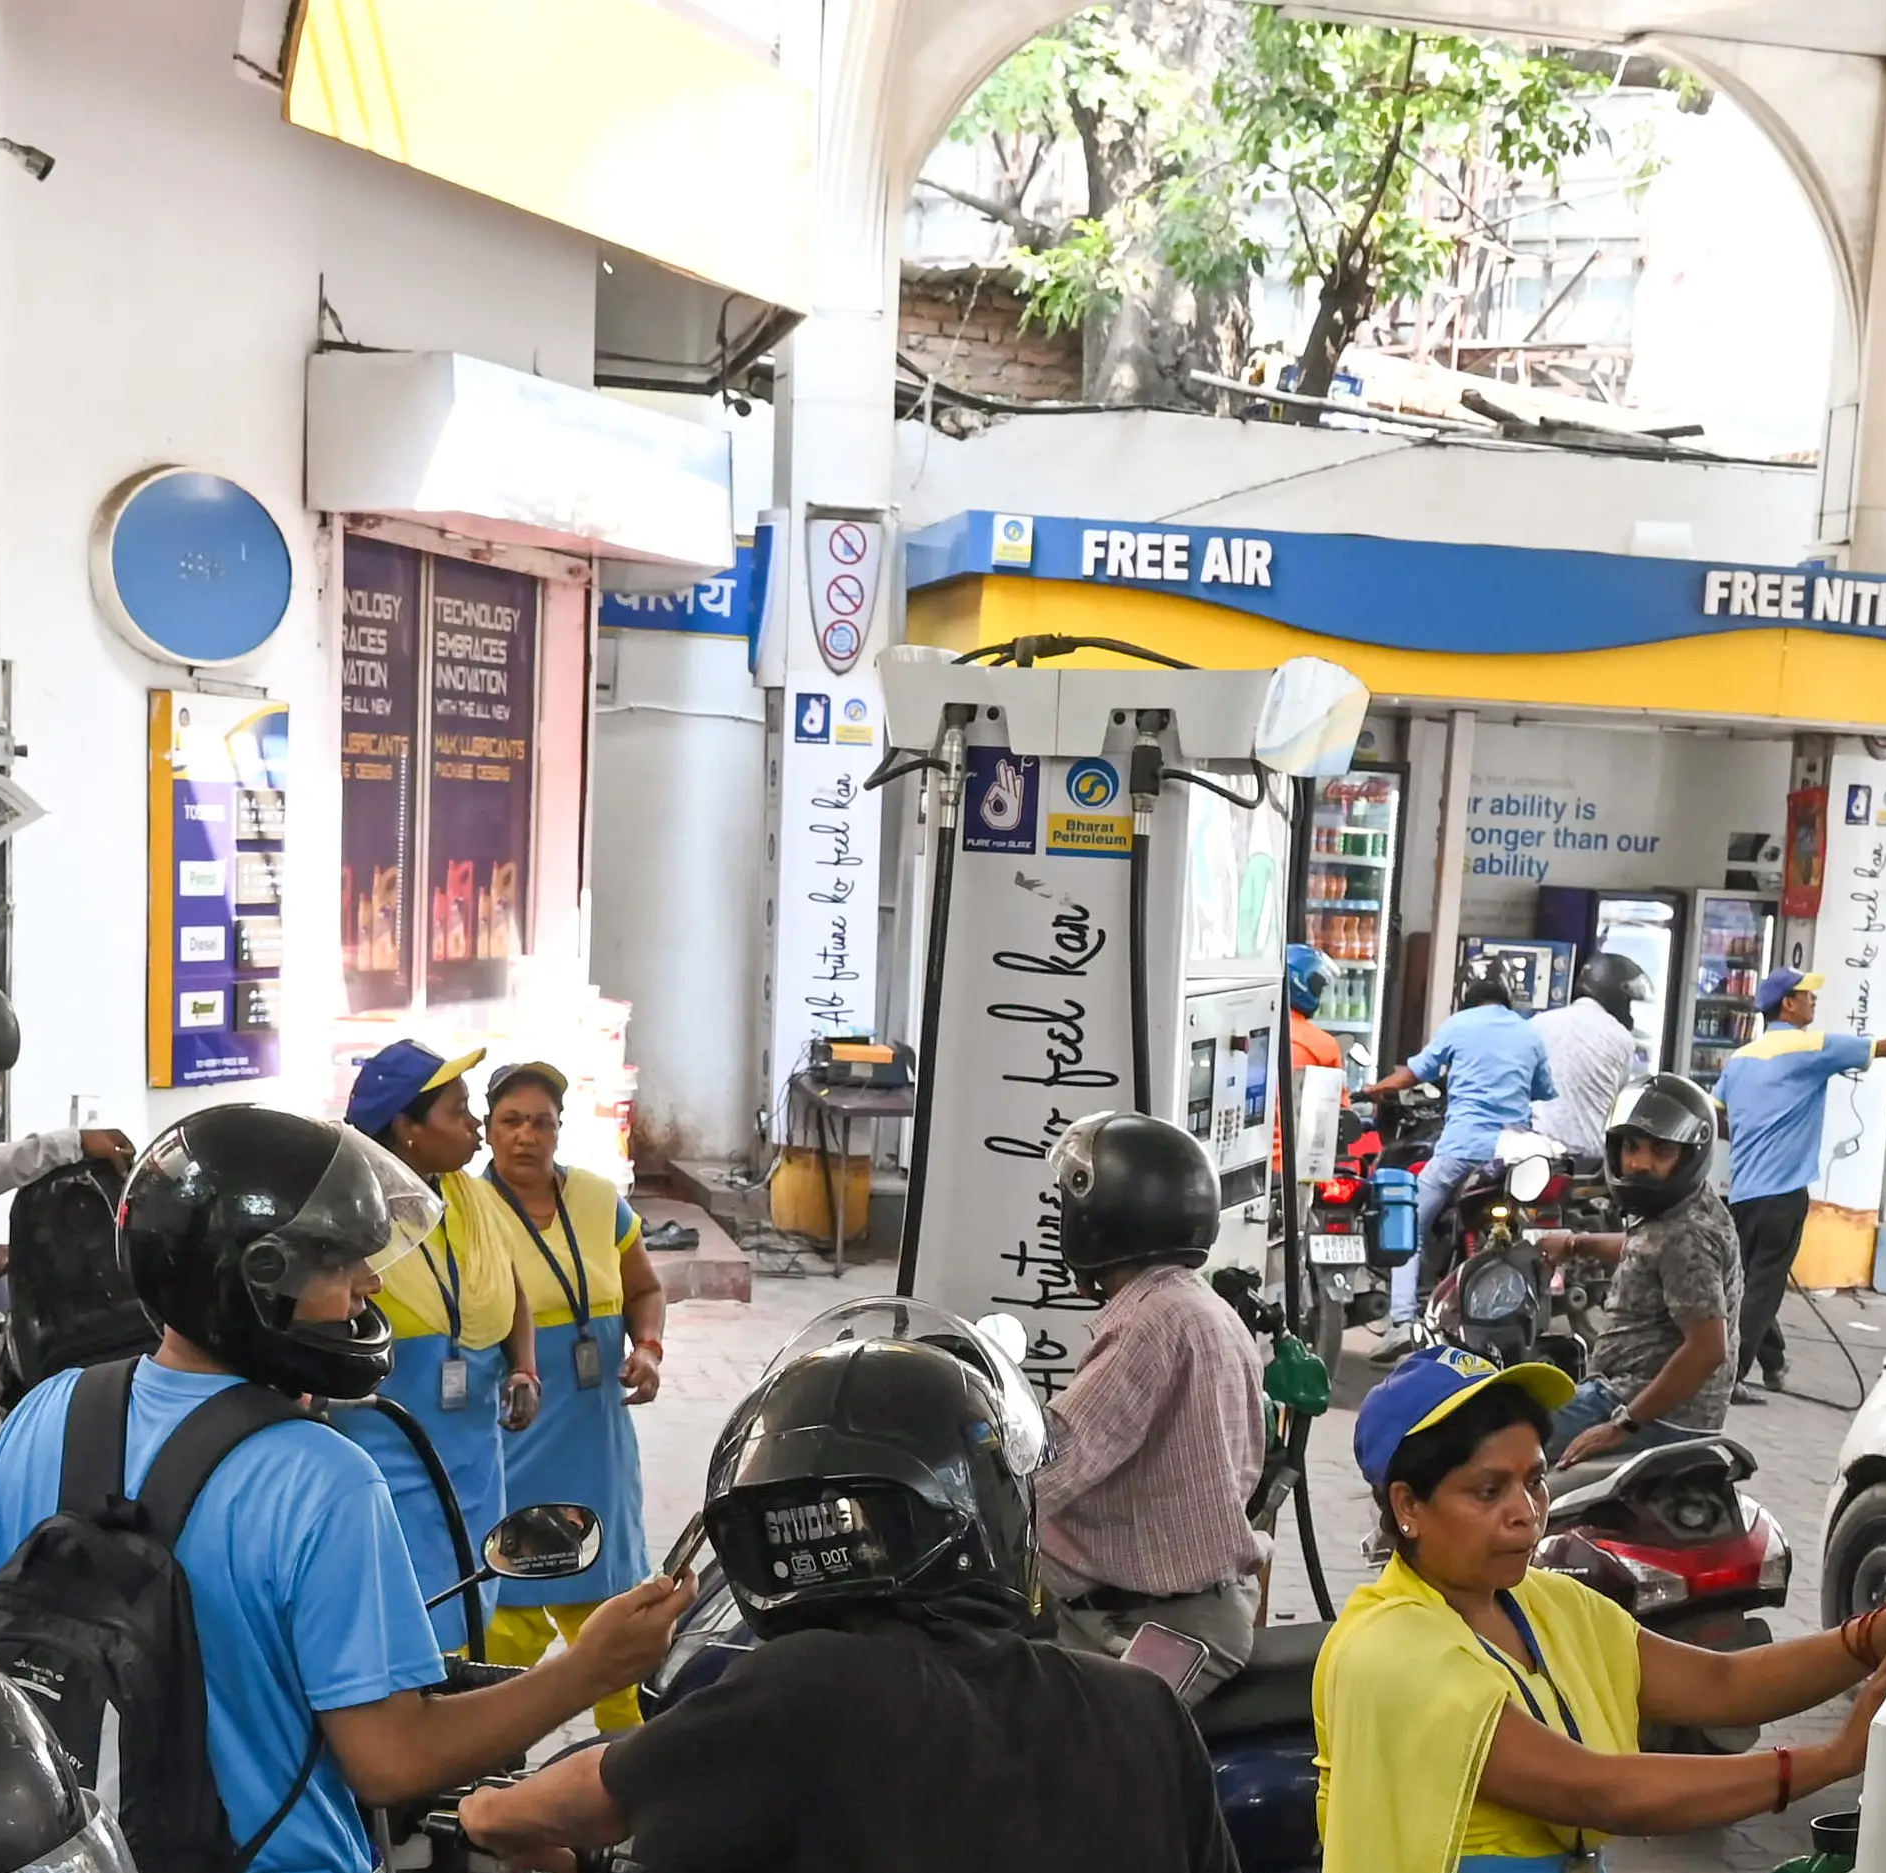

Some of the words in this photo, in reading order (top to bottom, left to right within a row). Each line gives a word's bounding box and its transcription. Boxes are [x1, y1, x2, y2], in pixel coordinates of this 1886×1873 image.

[1081, 529, 1190, 581] FREE
[1199, 537, 1273, 587] AIR
[344, 589, 402, 622] NOLOGY
[1703, 570, 1806, 619] FREE
[435, 596, 521, 634] TECHNOLOGY
[343, 626, 387, 656] RACES
[435, 631, 508, 664] EMBRACES
[342, 660, 388, 690] VATION
[435, 662, 508, 696] INNOVATION
[371, 698, 393, 716] NEW
[343, 732, 409, 757] UBRICANTS
[811, 772, 858, 809] kar
[1490, 794, 1567, 823] ability
[1575, 798, 1597, 820] is
[1053, 831, 1128, 846] Petroleum
[1066, 819, 1115, 833] Bharat
[1466, 826, 1546, 852] onger
[1553, 826, 1608, 850] than
[1617, 834, 1660, 853] our
[809, 820, 863, 866] feel
[1463, 853, 1549, 883] sability
[1854, 842, 1886, 879] kar
[808, 877, 855, 904] ko
[1850, 889, 1886, 933] feel
[812, 915, 860, 981] future
[992, 903, 1106, 977] kar
[1846, 944, 1879, 969] ko
[805, 990, 854, 1027] Ab
[1847, 979, 1870, 1038] uture
[986, 999, 1119, 1088] feel
[765, 1497, 854, 1545] STUDDS
[821, 1547, 849, 1565] DOT
